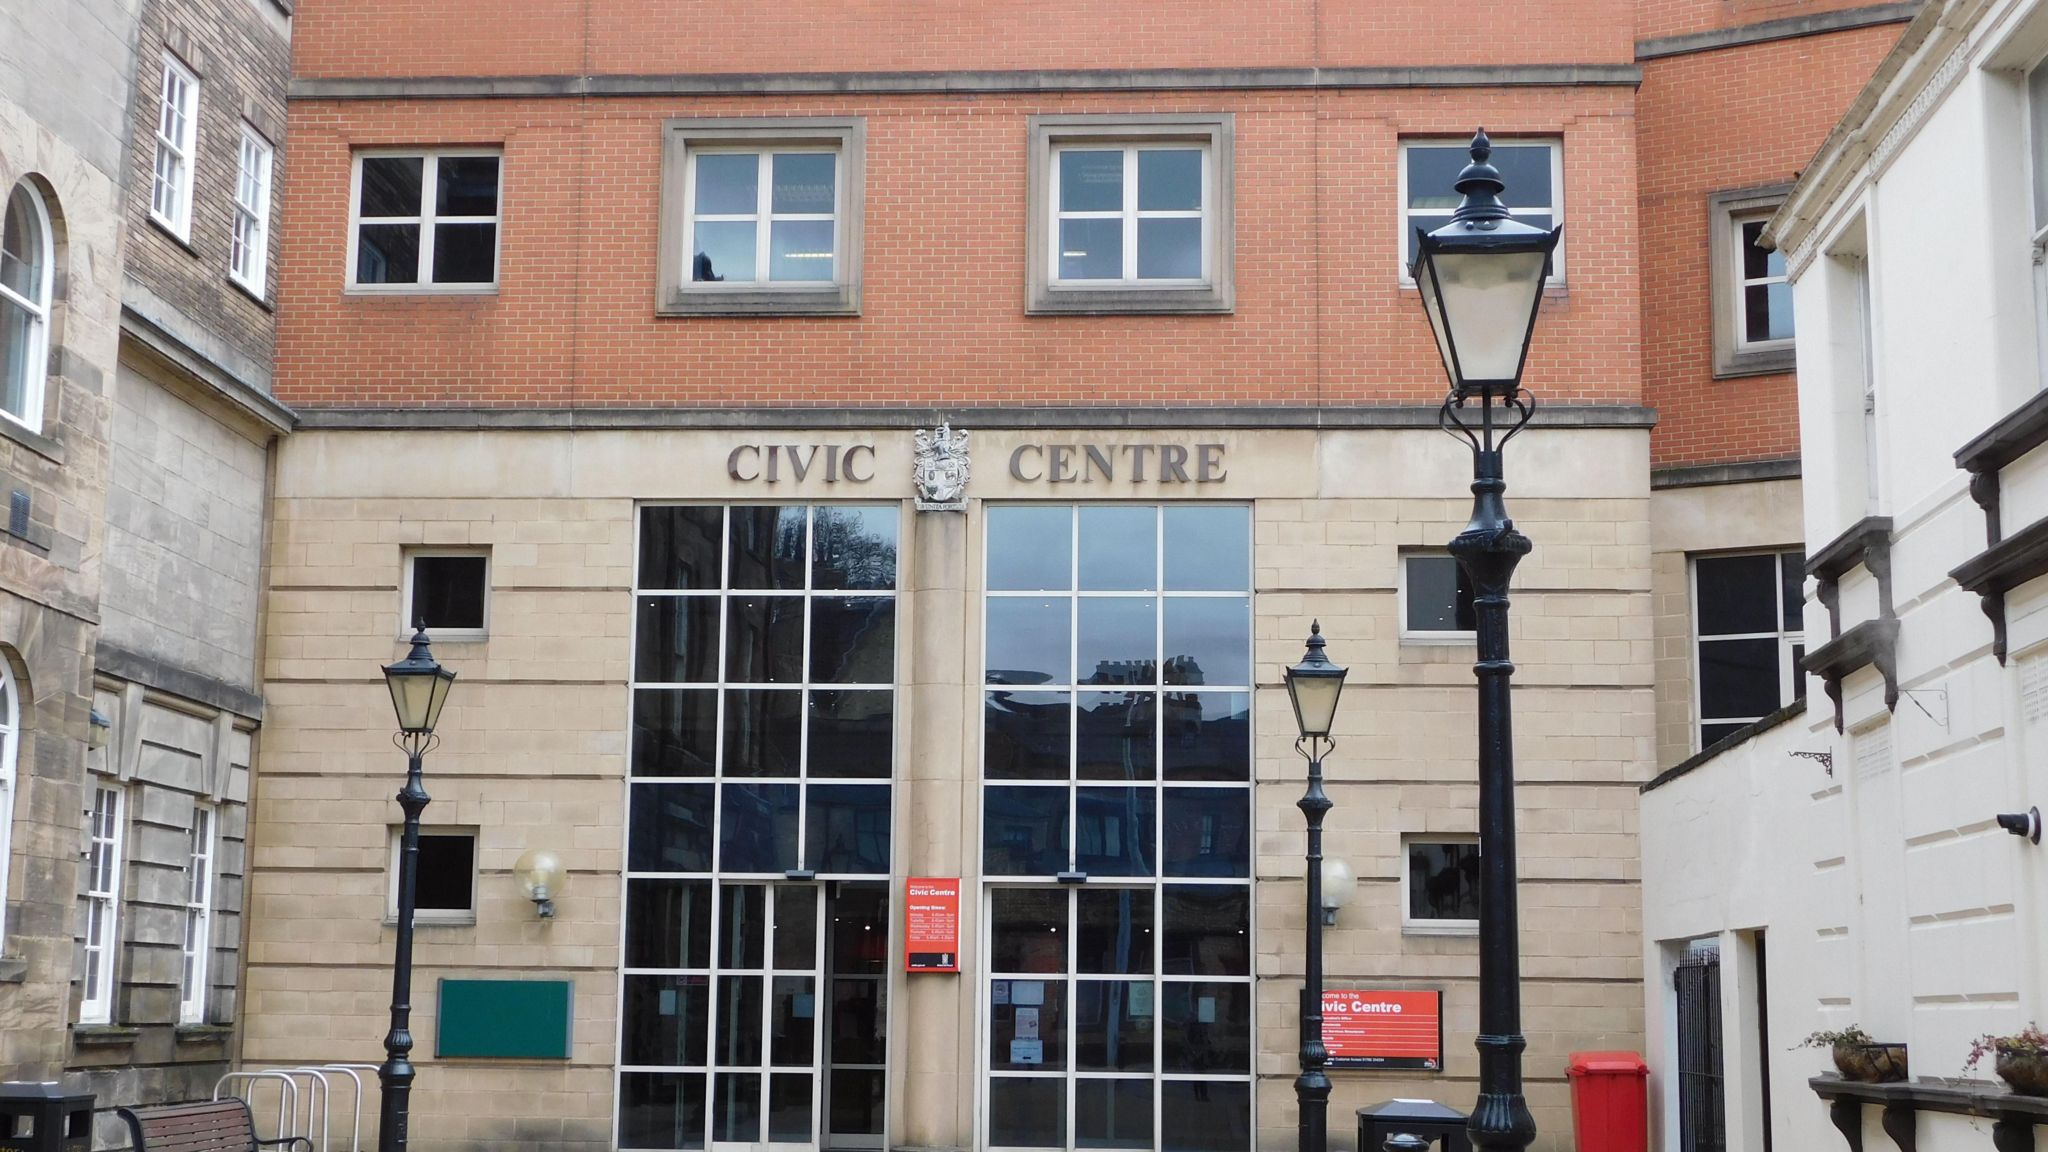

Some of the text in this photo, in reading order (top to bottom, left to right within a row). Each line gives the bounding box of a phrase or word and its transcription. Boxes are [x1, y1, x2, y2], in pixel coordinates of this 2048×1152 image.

[727, 443, 1228, 483] CIVIC CENTRE
[1321, 1001, 1402, 1013] ivic Centre
